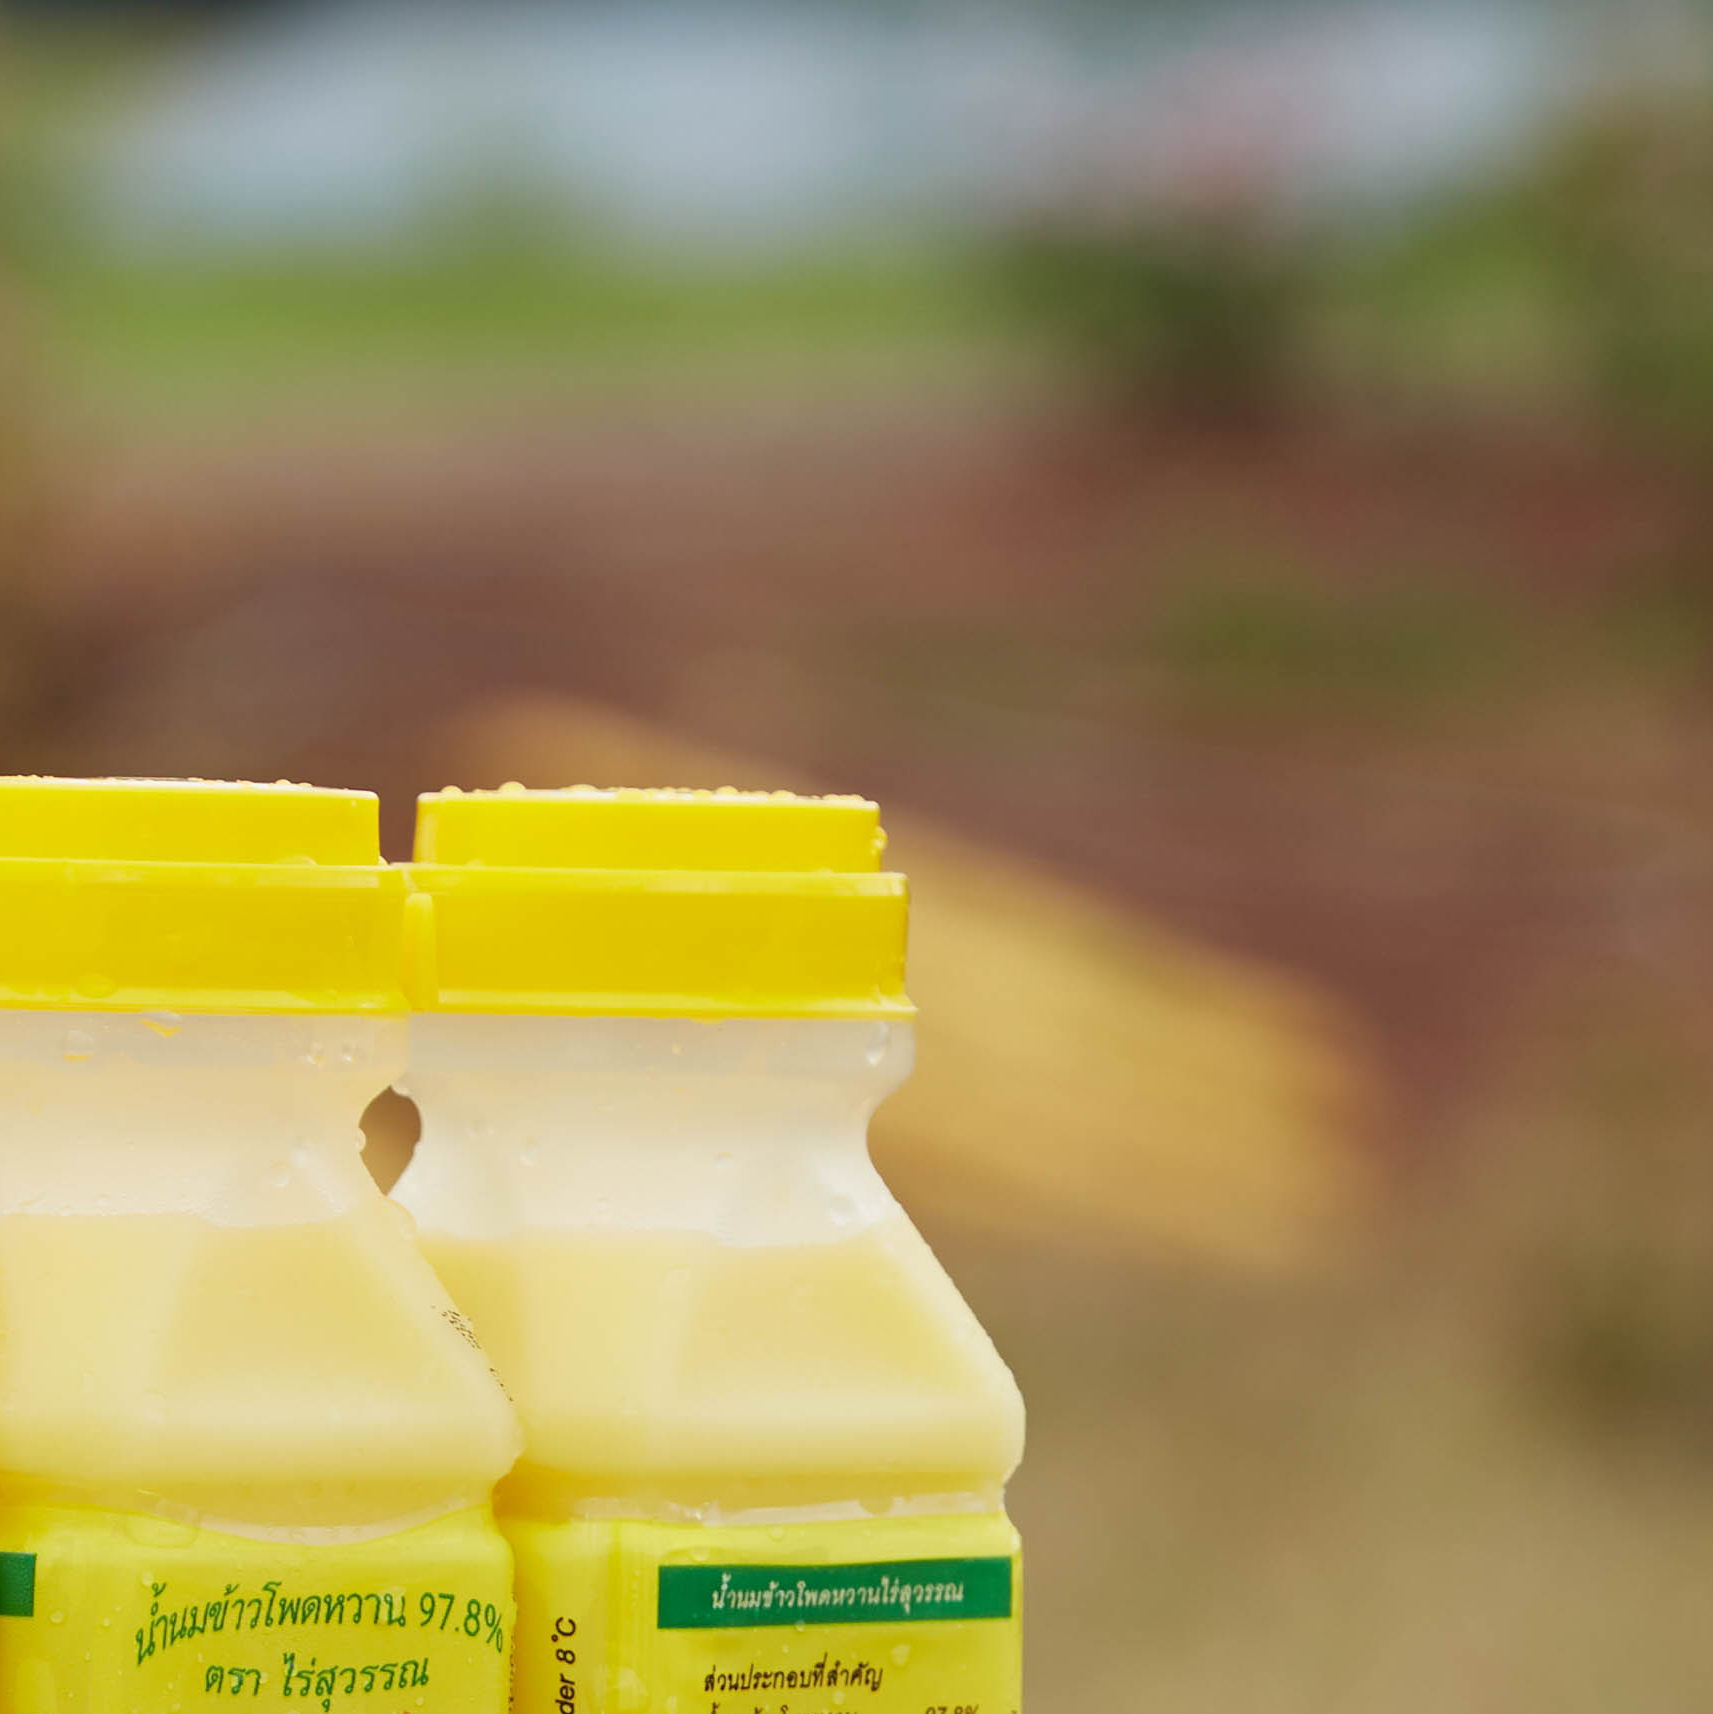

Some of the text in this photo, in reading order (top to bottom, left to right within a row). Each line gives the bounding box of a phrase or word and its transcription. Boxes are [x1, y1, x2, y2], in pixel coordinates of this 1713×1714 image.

[710, 1573, 965, 1616] น้ำนมข้าวโพดหวานไร่สุวรรณ
[135, 1580, 505, 1668] น้ำนมข้าวโพดหวาน 97.8%
[204, 1651, 431, 1713] ตรา ไร่สุวรรณ
[703, 1652, 884, 1692] ส่วนประกอบที่สำคัญ
